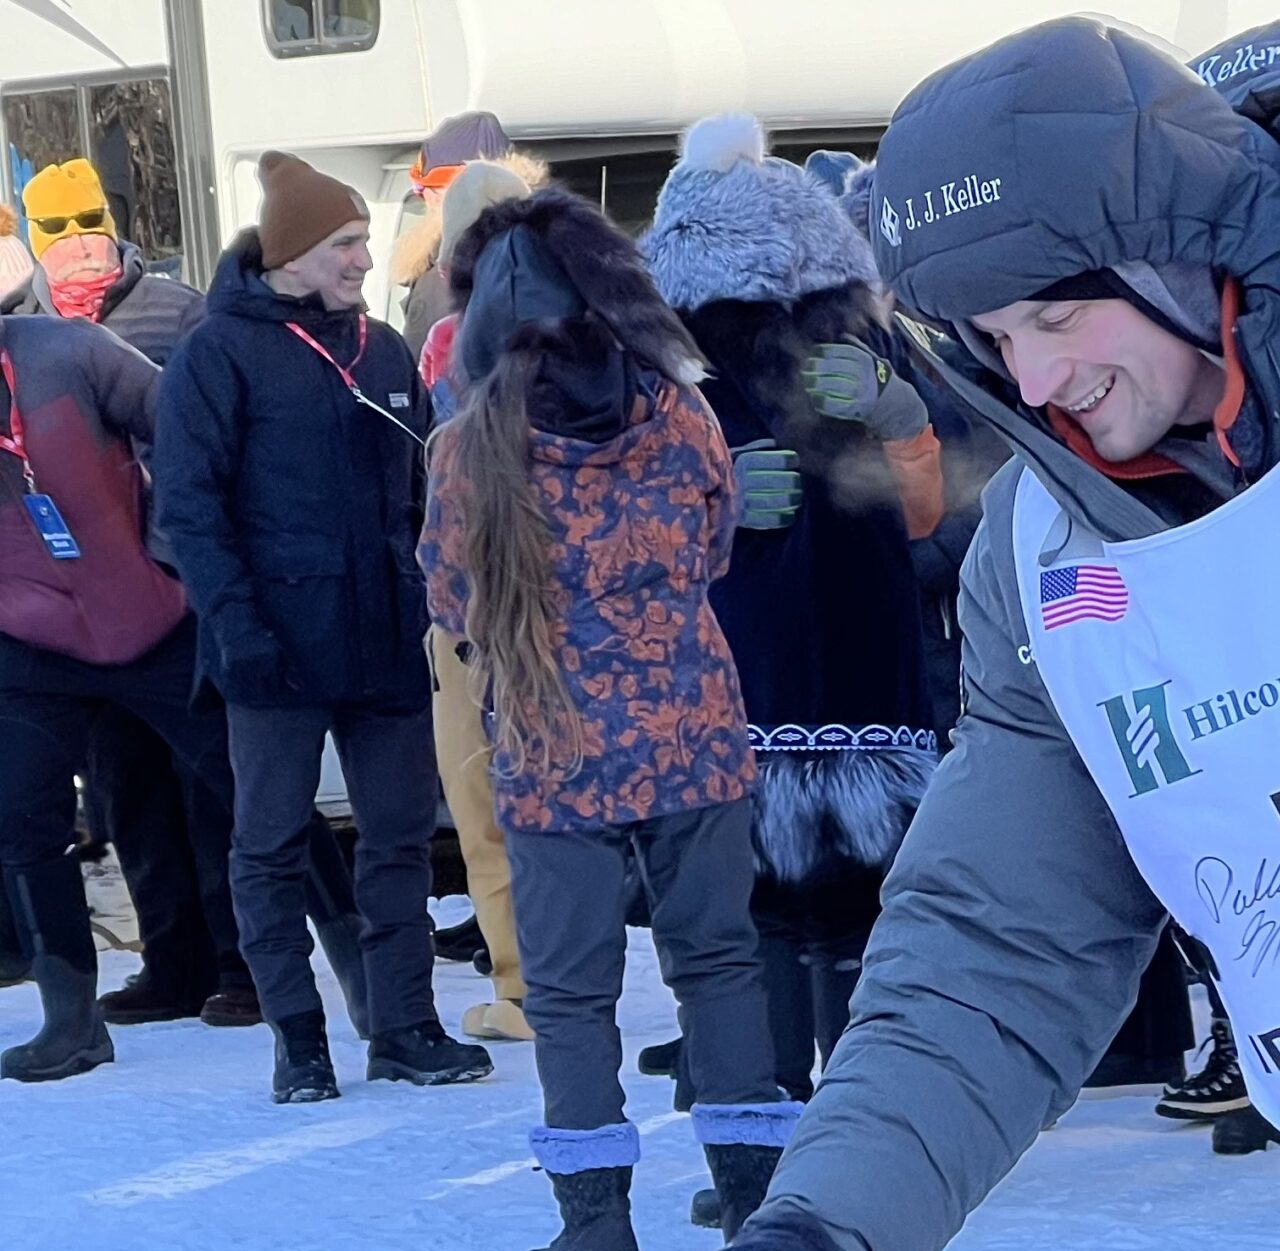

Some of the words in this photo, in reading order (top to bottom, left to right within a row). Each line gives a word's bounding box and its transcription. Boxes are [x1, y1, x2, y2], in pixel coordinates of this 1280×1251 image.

[1198, 44, 1280, 88] Keller
[905, 198, 921, 231] J.
[924, 191, 940, 223] J.
[940, 174, 1001, 216] Keller
